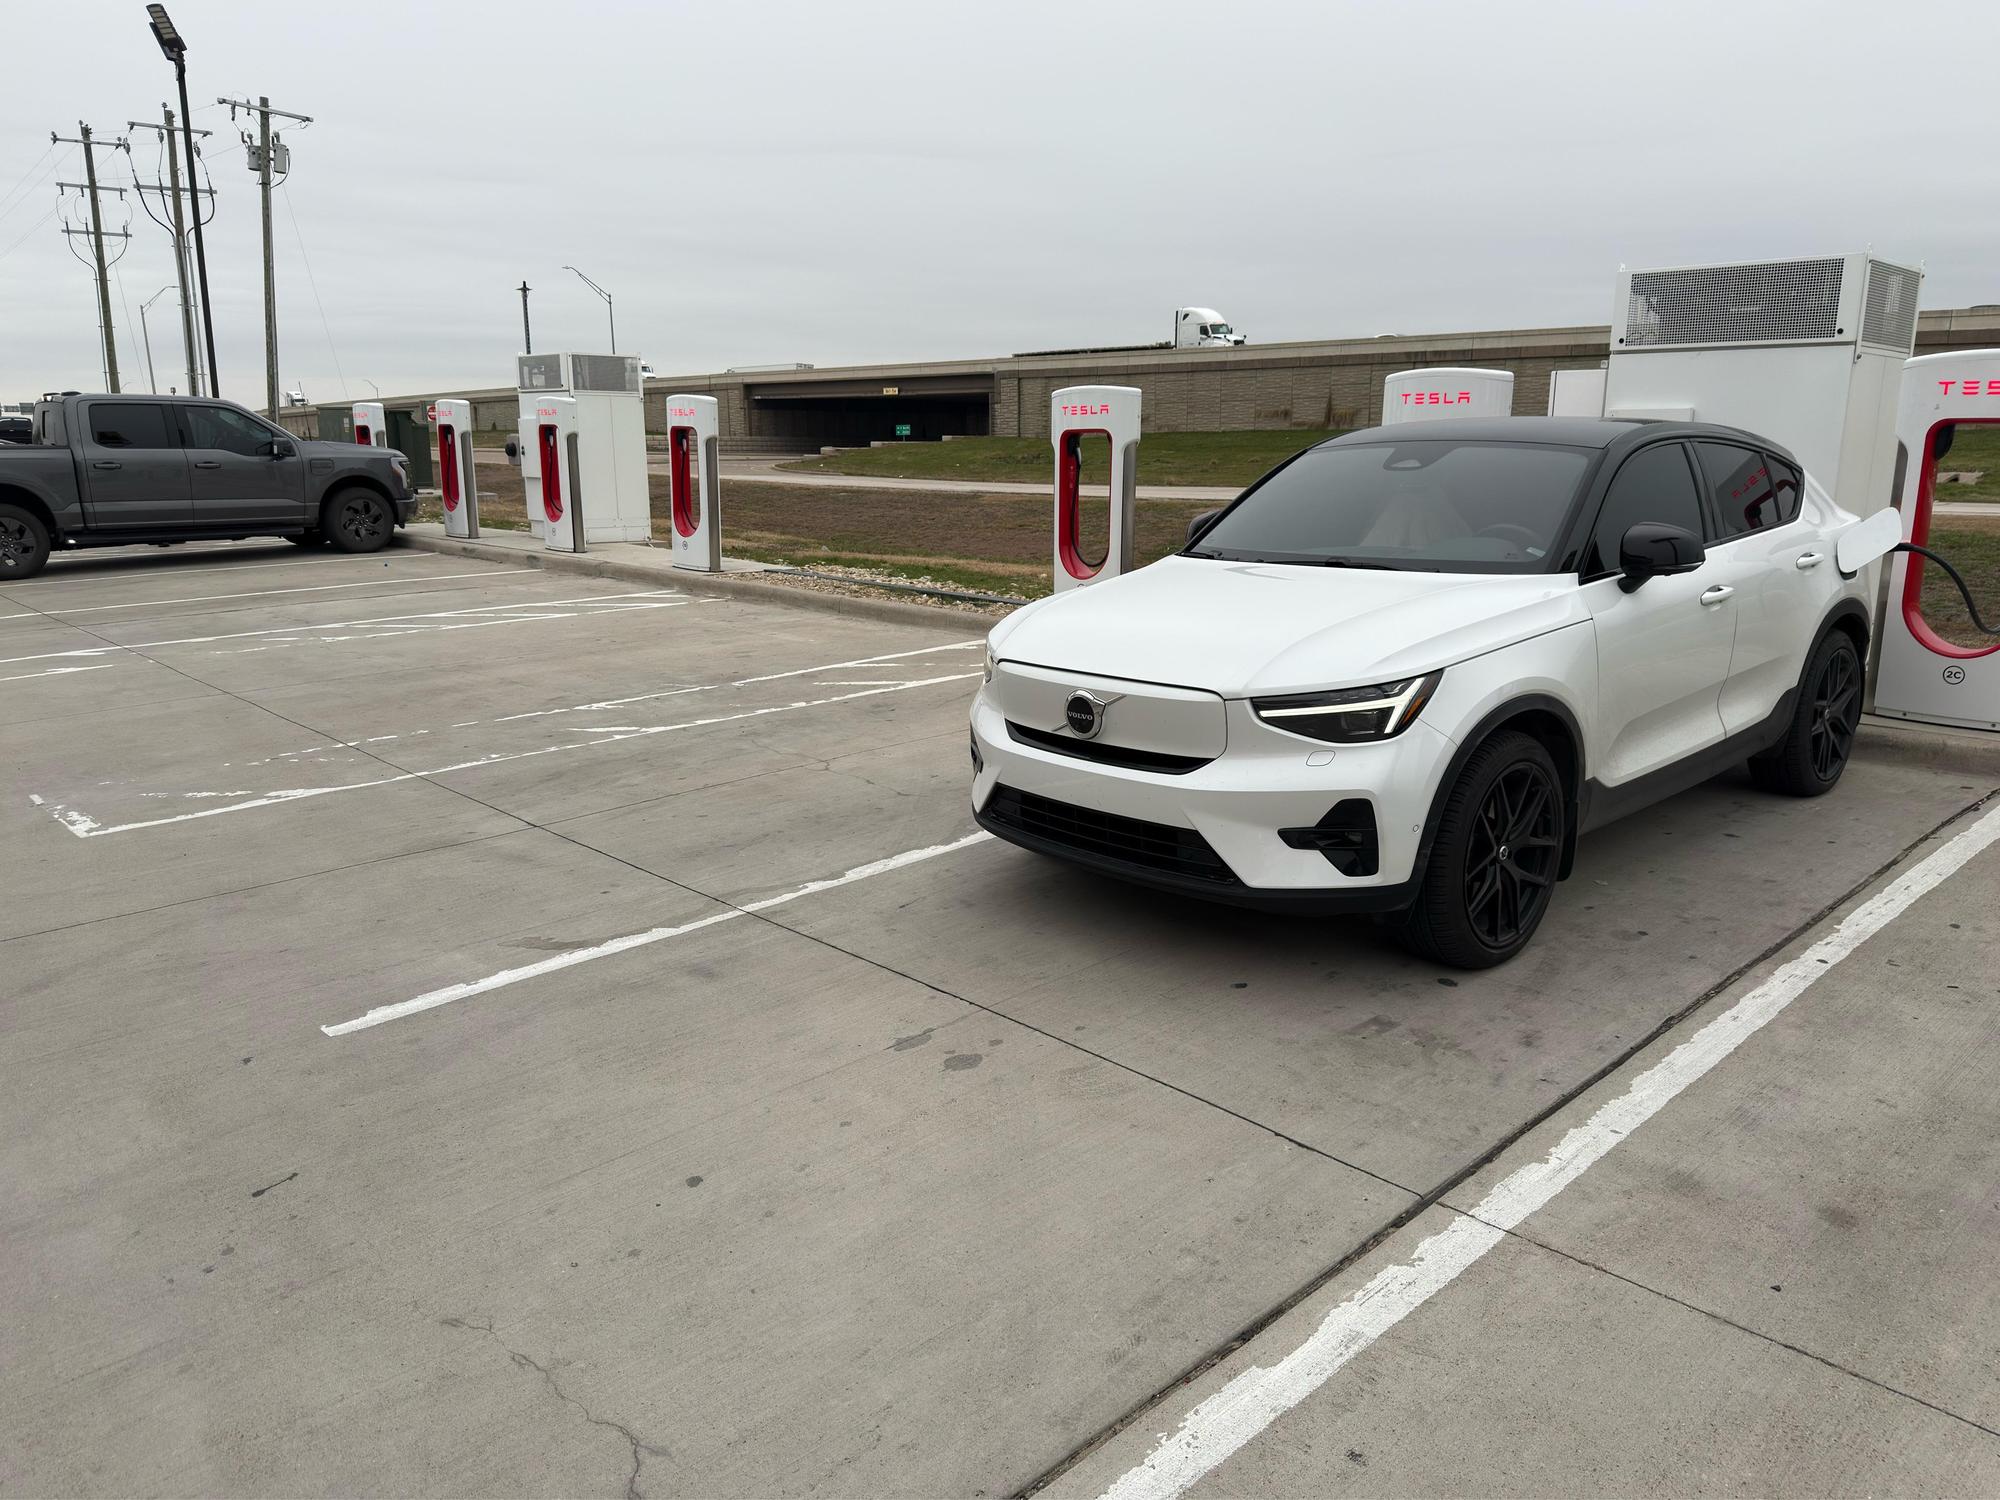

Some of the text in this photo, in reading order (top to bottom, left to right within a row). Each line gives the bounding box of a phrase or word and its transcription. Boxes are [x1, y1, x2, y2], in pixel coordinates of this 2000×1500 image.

[1401, 391, 1471, 405] TESLA
[670, 408, 695, 417] TESLA
[1061, 404, 1109, 416] TESLA
[1946, 670, 1962, 680] 2C
[1067, 711, 1094, 721] VOLVO
